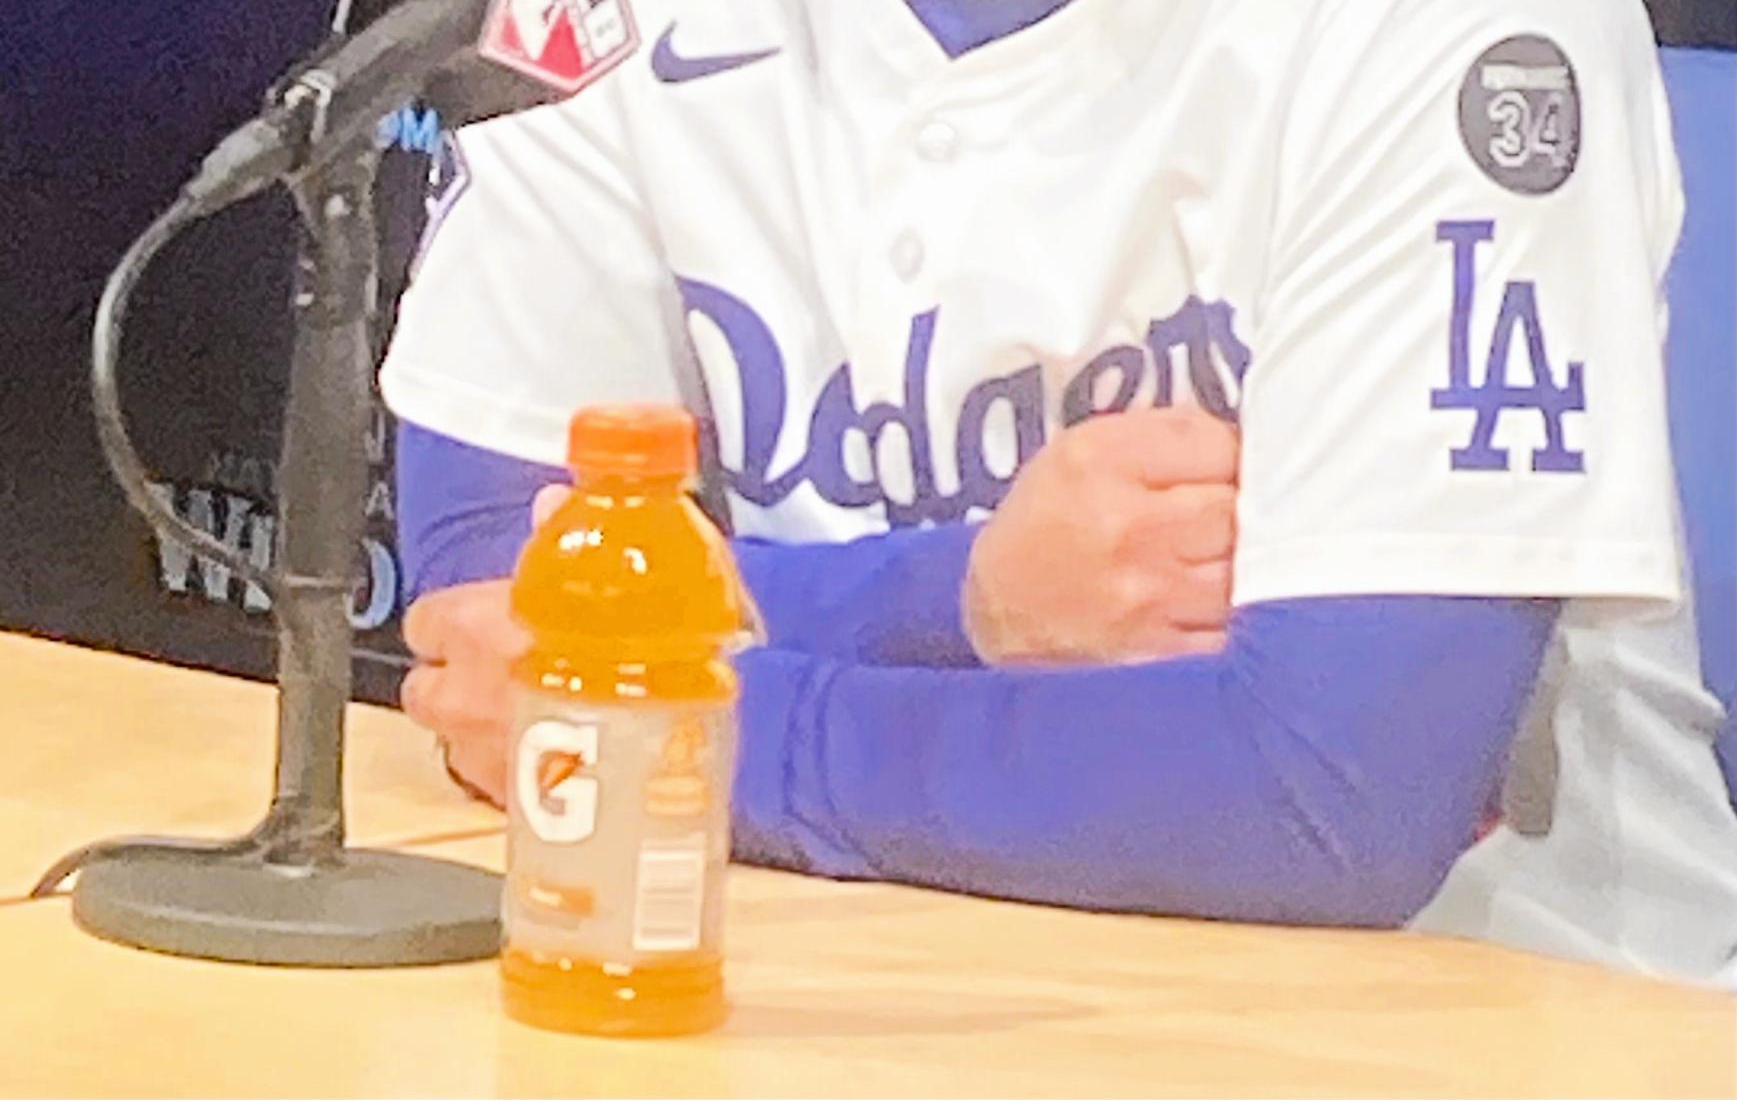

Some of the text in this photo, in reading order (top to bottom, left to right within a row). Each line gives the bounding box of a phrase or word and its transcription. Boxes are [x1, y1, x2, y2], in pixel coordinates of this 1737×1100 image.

[1487, 90, 1569, 167] 34
[1430, 219, 1586, 474] LA
[516, 720, 600, 843] G
